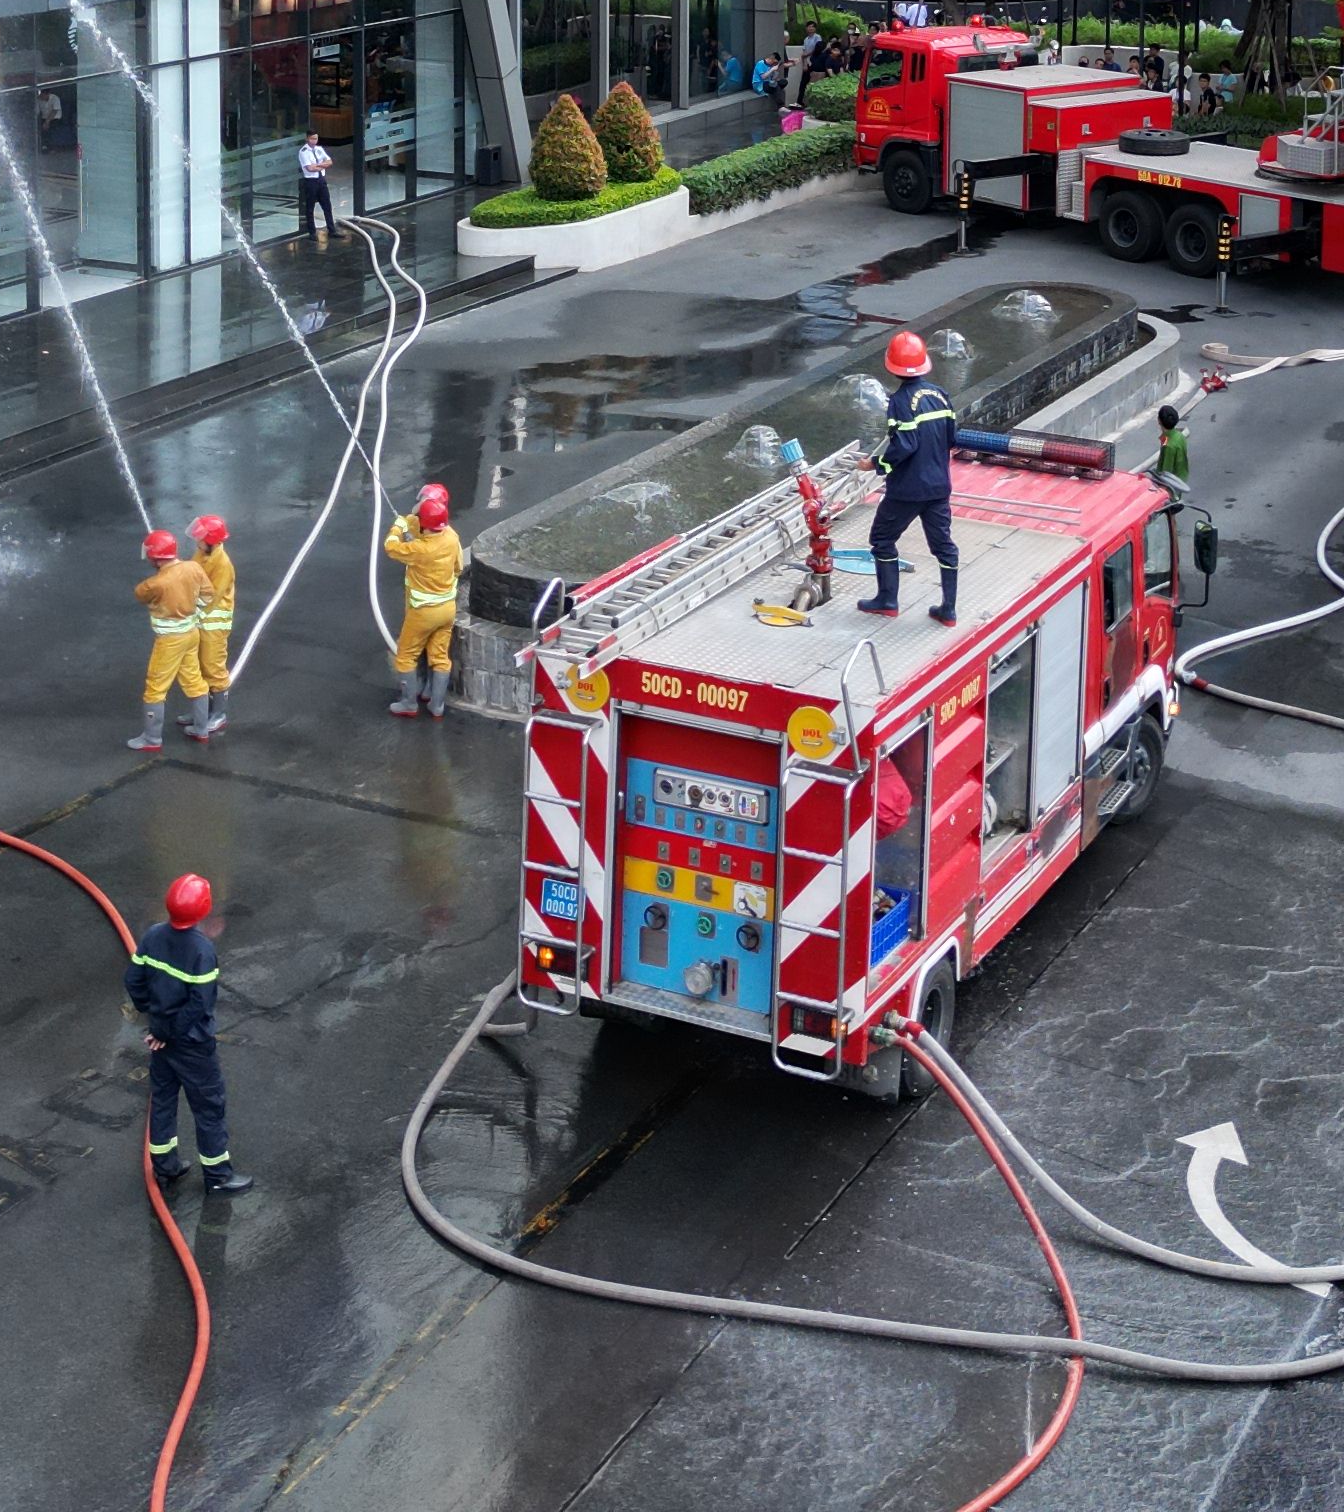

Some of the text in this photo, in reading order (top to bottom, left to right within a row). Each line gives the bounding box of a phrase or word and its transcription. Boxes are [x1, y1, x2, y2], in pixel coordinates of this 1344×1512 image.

[641, 671, 682, 700] 50CD
[696, 682, 749, 712] 00097
[551, 883, 577, 902] 50CD
